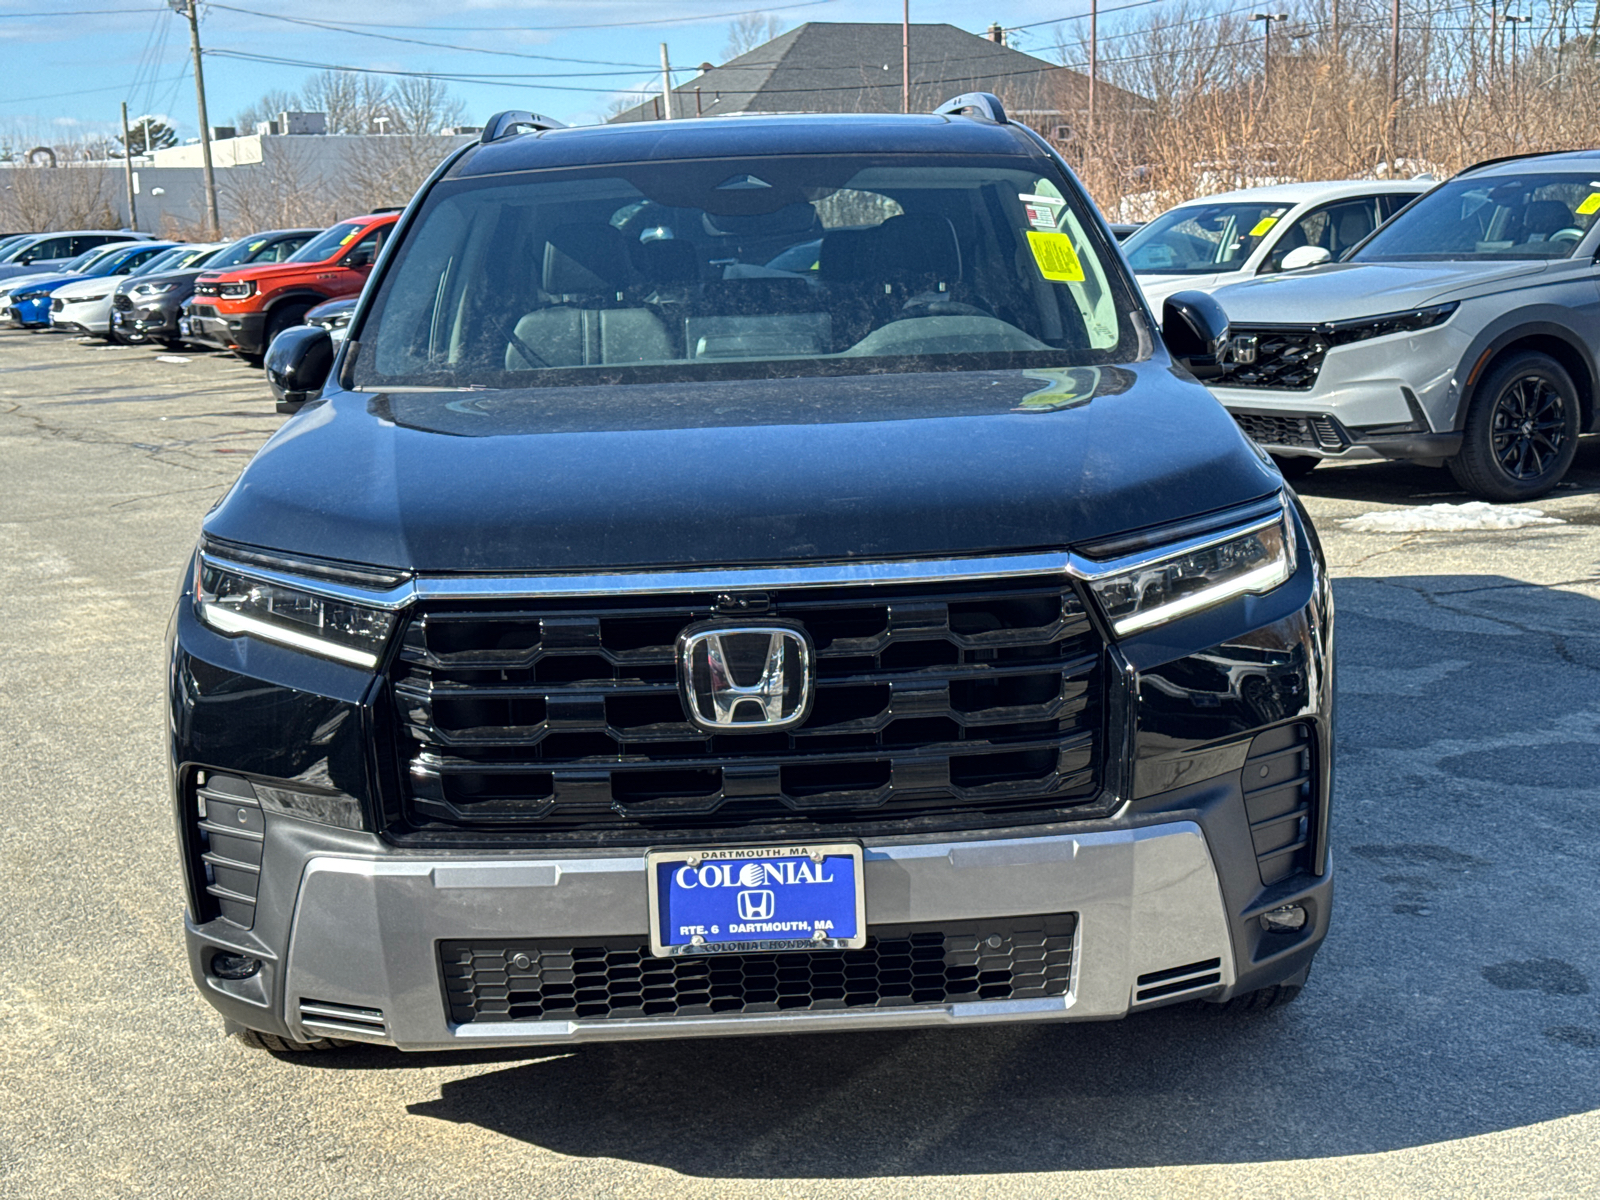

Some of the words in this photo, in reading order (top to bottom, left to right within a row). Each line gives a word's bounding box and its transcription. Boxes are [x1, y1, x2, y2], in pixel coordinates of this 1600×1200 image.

[789, 847, 809, 856] MA
[675, 861, 834, 889] COLONIAL
[680, 925, 708, 936] RTE.
[711, 925, 720, 935] 6
[729, 921, 812, 933] DARTMOUTH,
[814, 919, 835, 931] MA
[705, 939, 765, 952] COLONIAL
